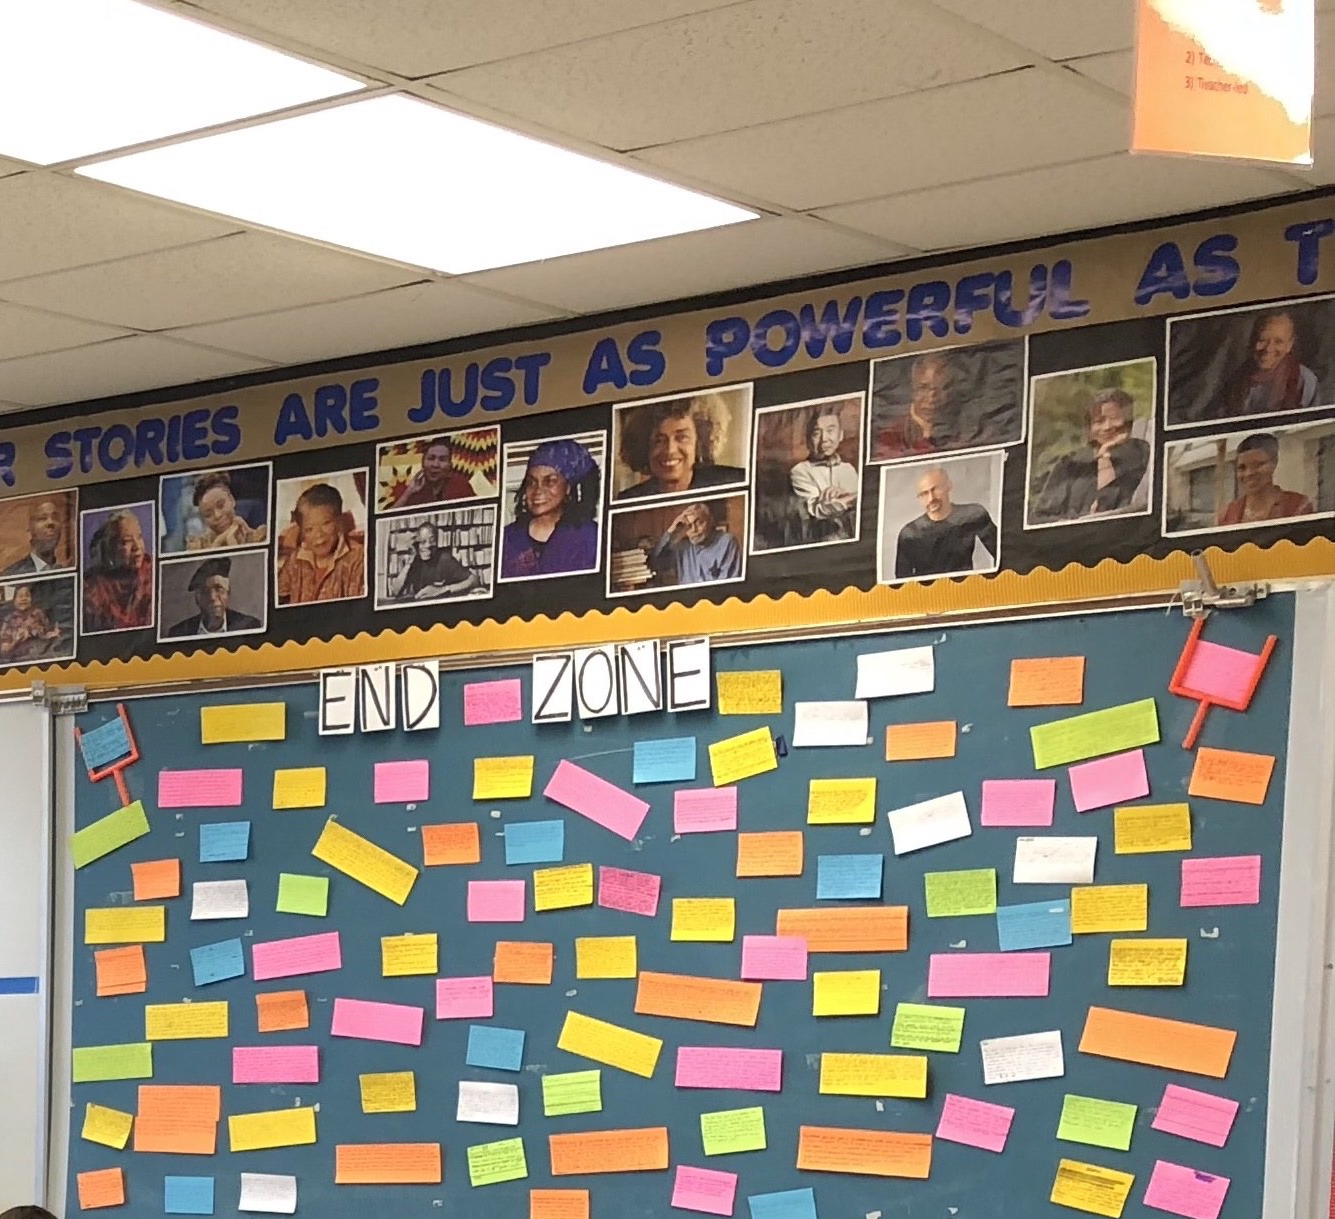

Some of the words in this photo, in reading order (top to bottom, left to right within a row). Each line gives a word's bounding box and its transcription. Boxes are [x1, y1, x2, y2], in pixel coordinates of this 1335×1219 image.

[43, 406, 242, 480] STORIES
[274, 379, 380, 446] ARE
[407, 352, 552, 424] JUST
[581, 330, 667, 396] AS
[705, 259, 1091, 377] POWERFUL
[1134, 234, 1241, 306] AS
[321, 665, 438, 733] END
[533, 638, 709, 722] ZONE
